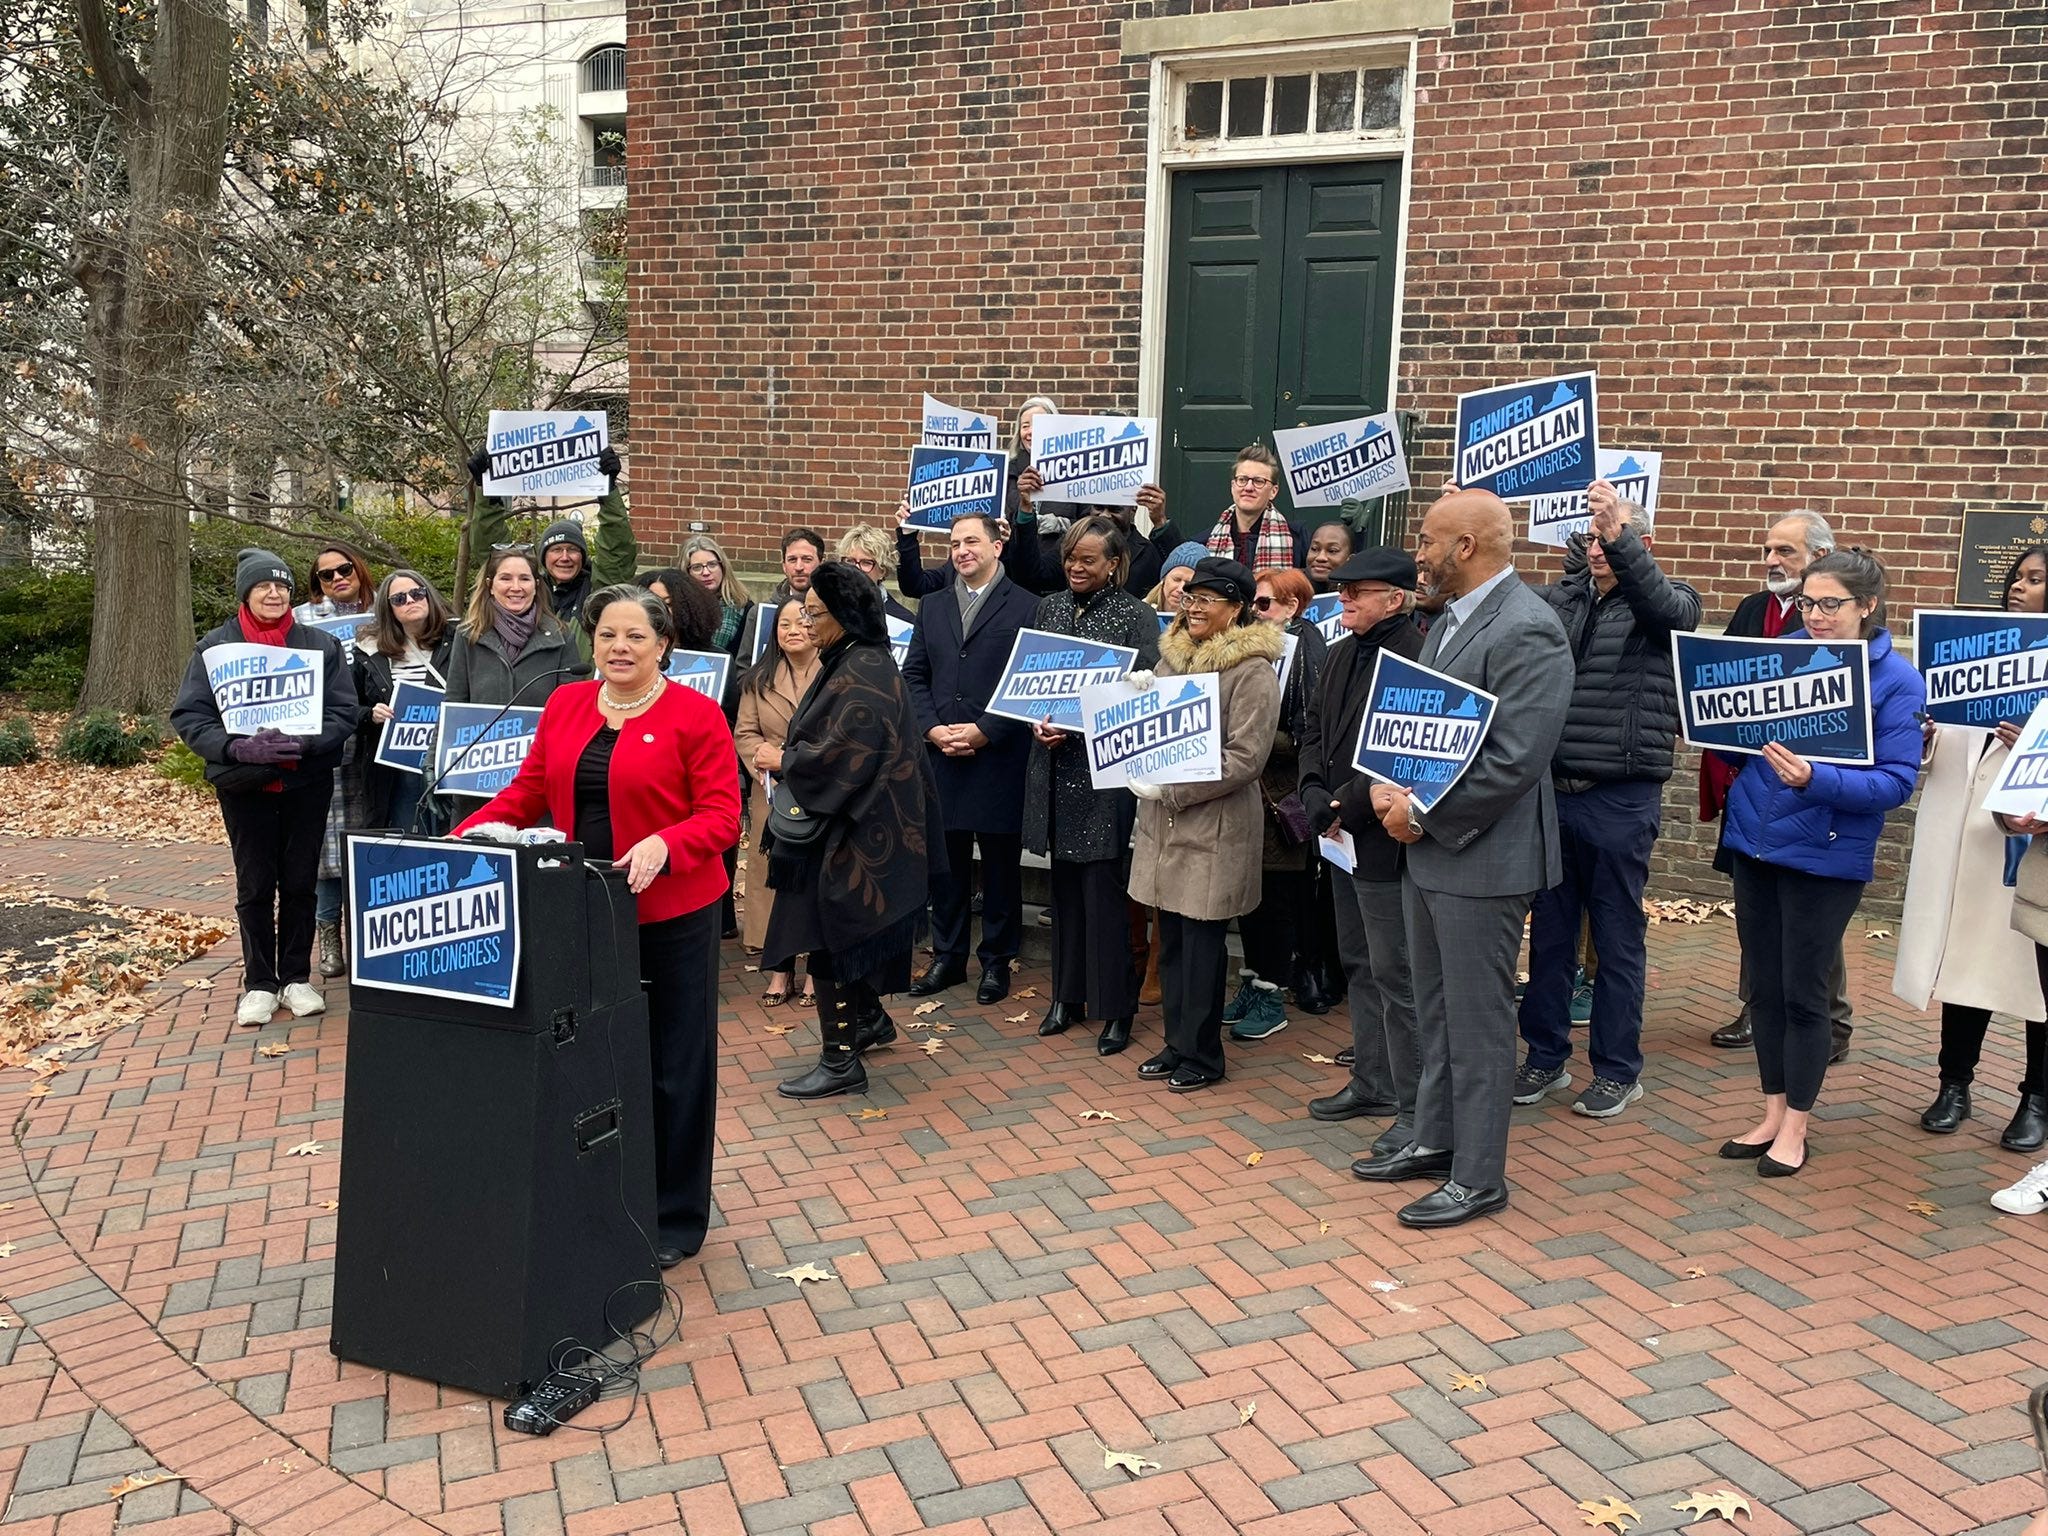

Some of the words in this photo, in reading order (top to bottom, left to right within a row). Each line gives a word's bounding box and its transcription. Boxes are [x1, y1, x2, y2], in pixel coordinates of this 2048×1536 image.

[491, 421, 557, 451] JENNIFER
[925, 416, 959, 431] JENNIFER
[1466, 395, 1534, 446] JENNIFER
[491, 434, 598, 477] MCCLELLAN
[1040, 426, 1105, 456] JENNIFER
[1290, 432, 1349, 467] JENNIFER
[1465, 406, 1580, 479] MCCLELLAN
[522, 474, 543, 492] FOR
[545, 461, 600, 486] CONGRESS
[913, 457, 959, 484] JENNIFER
[1039, 441, 1145, 482] MCCLELLAN
[1293, 435, 1392, 492] MCCLELLAN
[1496, 470, 1518, 494] FOR
[1520, 443, 1581, 487] CONGRESS
[912, 473, 994, 509] MCCLELLAN
[1067, 482, 1087, 498] FOR
[1089, 469, 1143, 494] CONGRESS
[1324, 484, 1343, 503] FOR
[1342, 460, 1396, 498] CONGRESS
[927, 507, 942, 524] FOR
[1019, 650, 1085, 671] JENNIFER
[1931, 627, 2022, 666] JENNIFER
[210, 656, 268, 687] ENNIFER
[1694, 653, 1784, 688] JENNIFER
[1931, 656, 2048, 699] MCCLELL
[216, 673, 311, 712] CCLELLAN
[1026, 700, 1050, 715] FOR
[1378, 687, 1446, 715] JENNIFER
[1696, 674, 1846, 721] MCCLELLAN
[1966, 699, 1992, 722] FOR
[1995, 690, 2048, 718] CONG
[228, 710, 249, 728] FOR
[251, 700, 309, 725] CONGRESS
[401, 705, 440, 722] JENN
[1094, 690, 1161, 734] JENNIFER
[1737, 724, 1764, 744] FOR
[1765, 710, 1848, 743] CONGRESS
[453, 718, 523, 746] JENNIFER
[1095, 702, 1208, 767] MCCLELLAN
[1372, 718, 1475, 755] MCCLELLAN
[450, 739, 531, 771] MCCLEL
[1125, 759, 1145, 779] FOR
[1145, 736, 1207, 775] CONGRESS
[1392, 756, 1412, 779] FOR
[476, 771, 498, 790] FOR
[368, 861, 449, 907] JENNIFER
[369, 890, 500, 950] MCCLELLAN
[403, 951, 428, 980] FOR
[431, 936, 501, 975] CONGRESS
